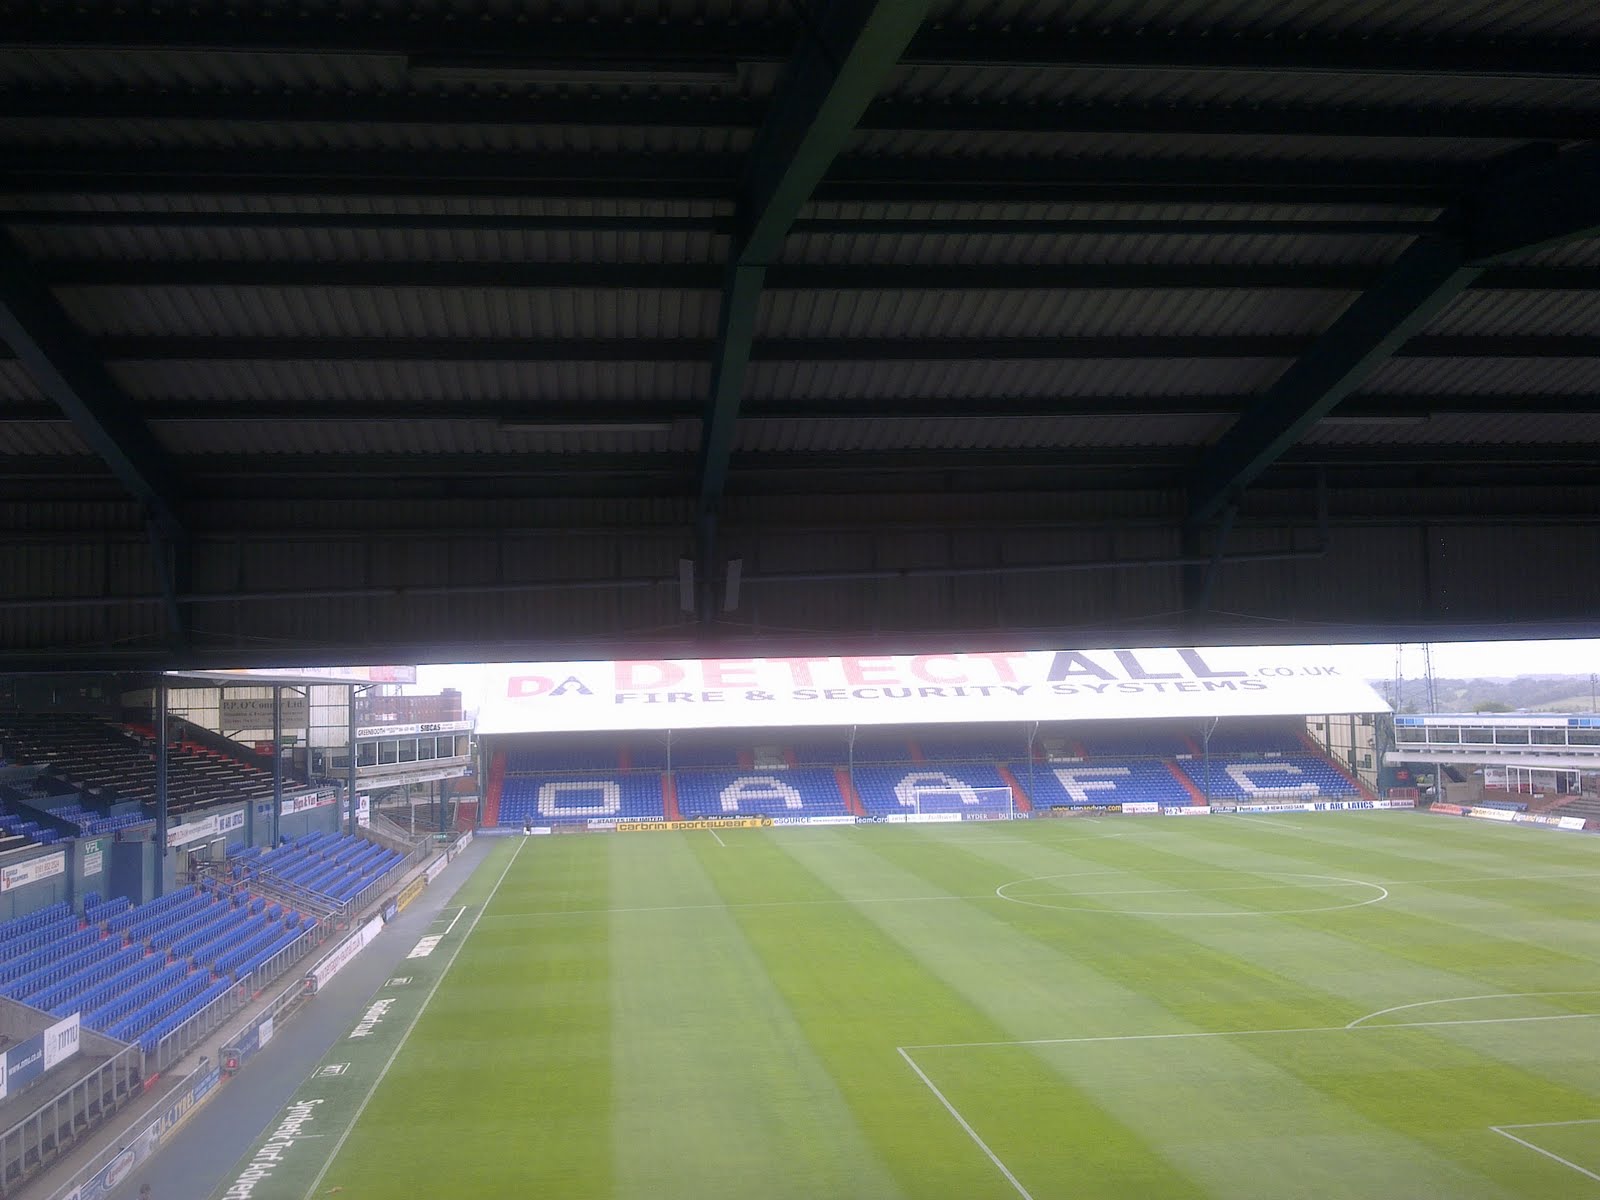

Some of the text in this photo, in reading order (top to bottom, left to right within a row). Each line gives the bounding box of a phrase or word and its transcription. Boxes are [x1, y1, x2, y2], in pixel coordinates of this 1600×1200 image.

[614, 679, 1268, 704] FIRE & SECURITY SYSTEMS
[240, 701, 285, 709] O'Connr
[420, 724, 441, 732] SIBCAS
[1314, 803, 1327, 811] WE
[1329, 802, 1345, 811] ARE
[1347, 801, 1374, 809] LATICS
[855, 815, 889, 824] TeamCard
[966, 813, 988, 821] RYDER
[998, 812, 1029, 820] DUTON
[618, 821, 668, 831] carbrini
[671, 819, 747, 830] sportswear
[267, 1098, 325, 1142] Synthetic
[253, 1139, 294, 1162] Turf
